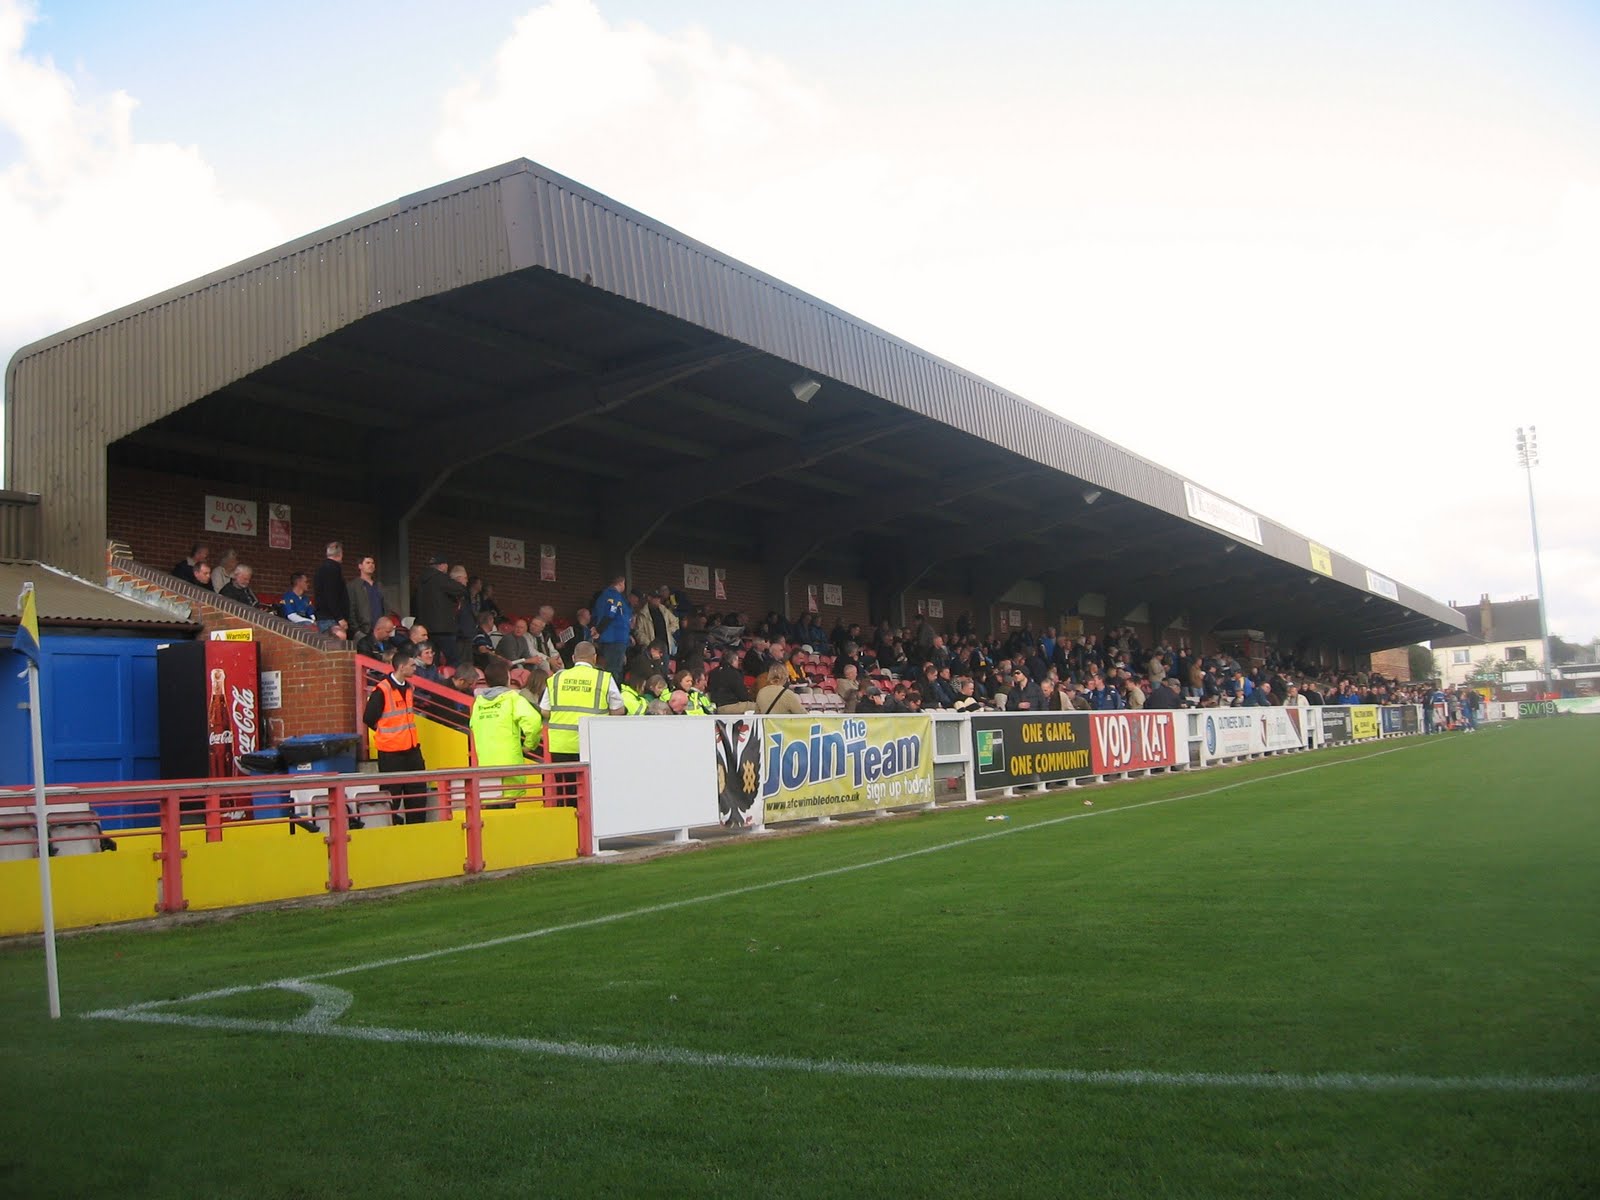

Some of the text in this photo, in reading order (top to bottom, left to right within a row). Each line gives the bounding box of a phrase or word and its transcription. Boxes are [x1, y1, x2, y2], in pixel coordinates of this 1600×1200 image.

[215, 500, 247, 515] BLOCK
[226, 515, 237, 530] A
[496, 540, 518, 551] BLOCK
[504, 551, 511, 564] B
[226, 632, 251, 641] Warning
[1519, 702, 1556, 716] SW19
[843, 719, 866, 740] the
[1022, 721, 1075, 743] ONE GAME,
[1010, 749, 1090, 777] ONE COMMUNITY
[866, 773, 932, 804] sign up today!
[766, 792, 861, 812] www.afcwimbledon.co.uk
